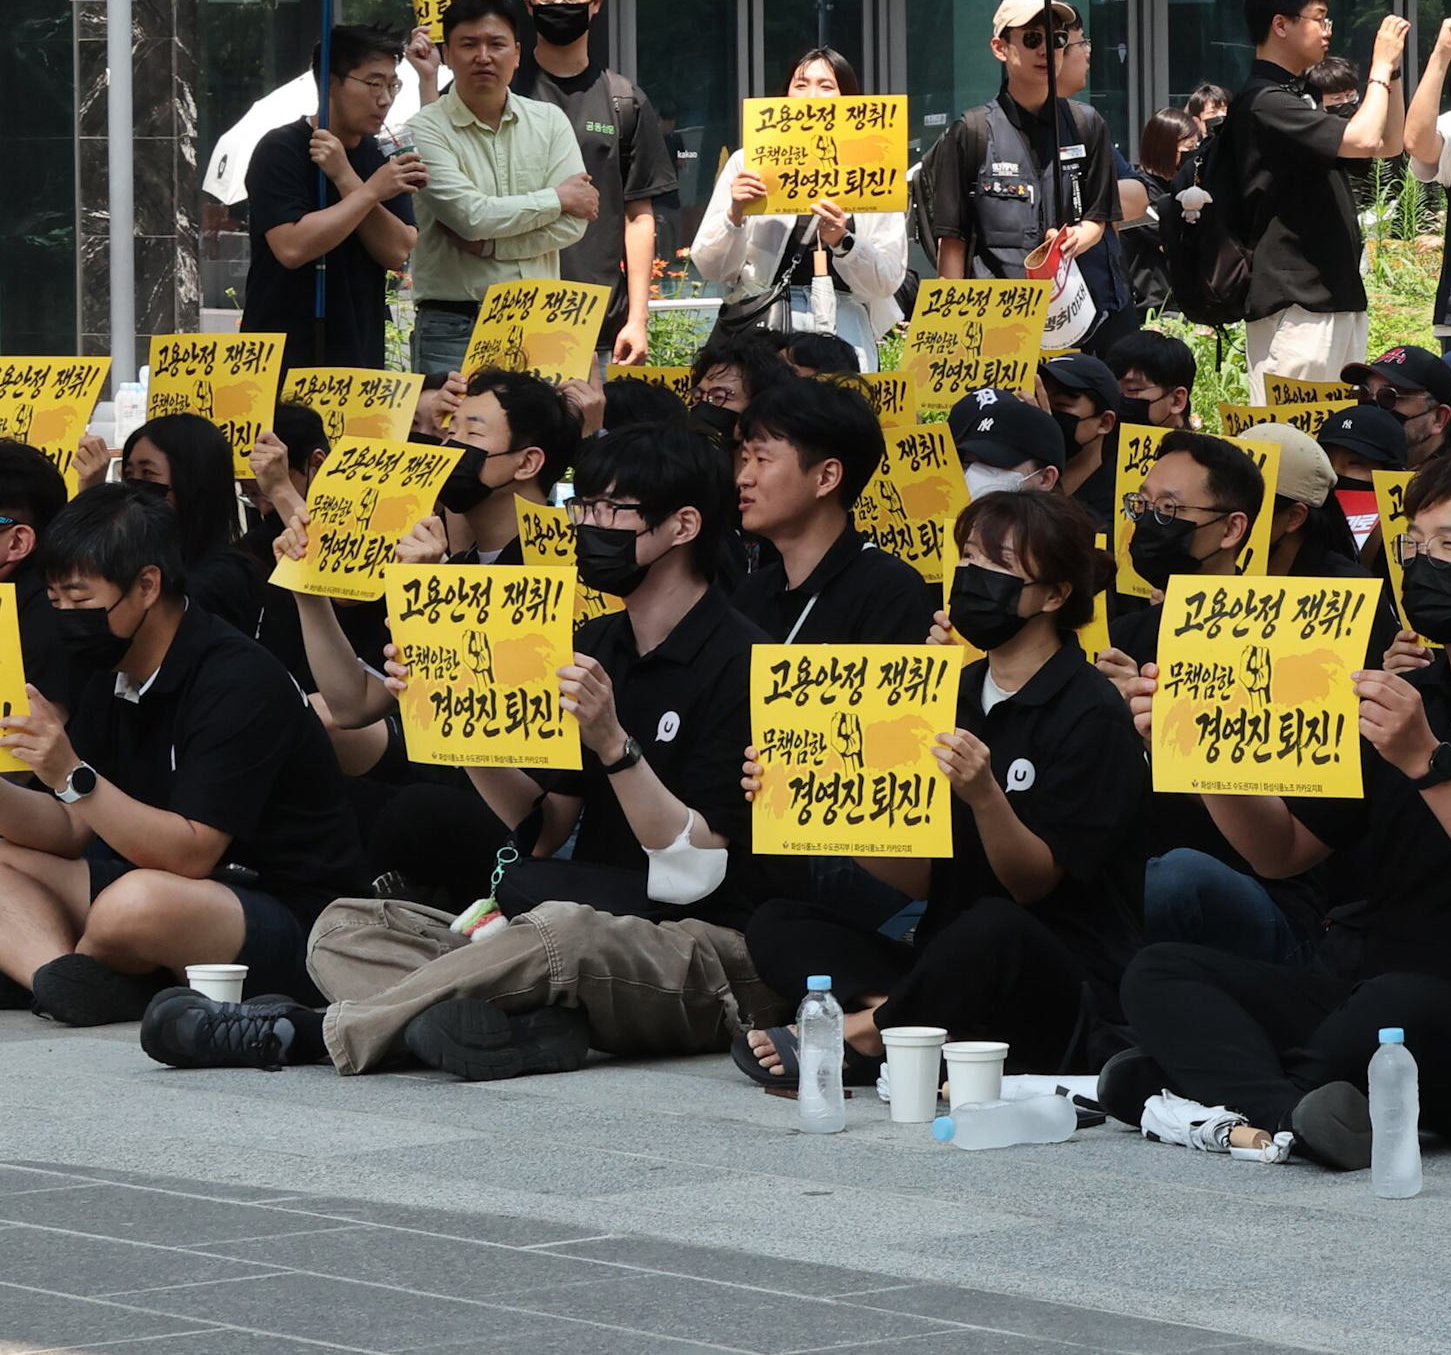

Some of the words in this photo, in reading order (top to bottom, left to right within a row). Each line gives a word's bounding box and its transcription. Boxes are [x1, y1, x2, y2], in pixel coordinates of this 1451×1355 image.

[756, 104, 835, 132] 고용안정
[847, 103, 896, 130] 쟁취!
[751, 145, 809, 166] 무책임한
[779, 169, 839, 199] 경영진
[844, 167, 896, 197] 퇴진!
[922, 287, 992, 317] 고용안정
[996, 287, 1043, 318] 쟁취!
[155, 342, 217, 377] 고용안정
[224, 341, 274, 375] 쟁취!
[911, 331, 958, 354] 무책임한
[929, 358, 979, 393] 경영진
[985, 361, 1031, 395] 퇴진!
[400, 575, 492, 624] 고용안정
[502, 577, 563, 625] 쟁취!
[1175, 588, 1285, 639] 고용안정
[1291, 589, 1365, 639] 쟁취!
[403, 645, 460, 681] 무책임한
[764, 656, 868, 706] 고용안정
[877, 656, 948, 706] 쟁취!
[1165, 662, 1235, 701] 무책임한
[430, 685, 500, 738] 경영진
[504, 688, 570, 740] 퇴진!
[760, 729, 827, 766] 무책임한
[1196, 706, 1271, 763] 경영진
[1277, 708, 1344, 766] 퇴진!
[789, 771, 864, 825] 경영진
[870, 772, 936, 827] 퇴진!
